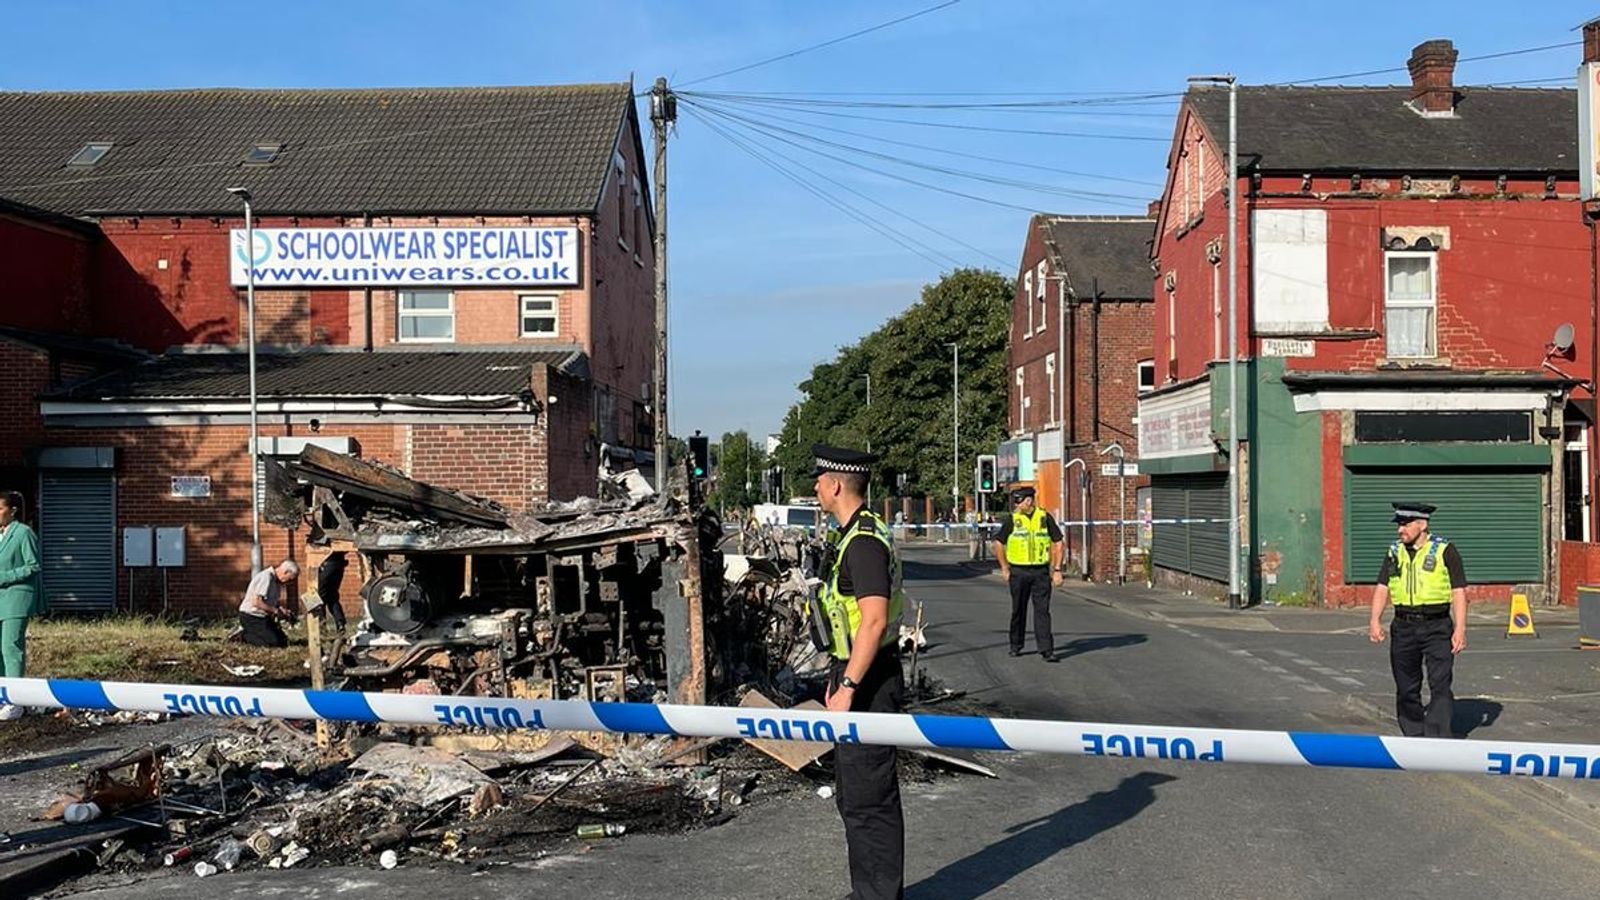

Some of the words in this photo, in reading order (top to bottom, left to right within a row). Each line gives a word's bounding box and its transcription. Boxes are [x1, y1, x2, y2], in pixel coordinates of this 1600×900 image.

[277, 231, 437, 260] SCHOOLWEAR
[443, 230, 568, 260] SPECIALIST
[244, 262, 569, 281] www.uniwears.co.uk
[163, 694, 265, 717] POLICE
[434, 705, 547, 729] POLICE
[736, 718, 860, 744] POLICE
[1082, 733, 1224, 762] POLICE
[1487, 753, 1600, 778] LICE
